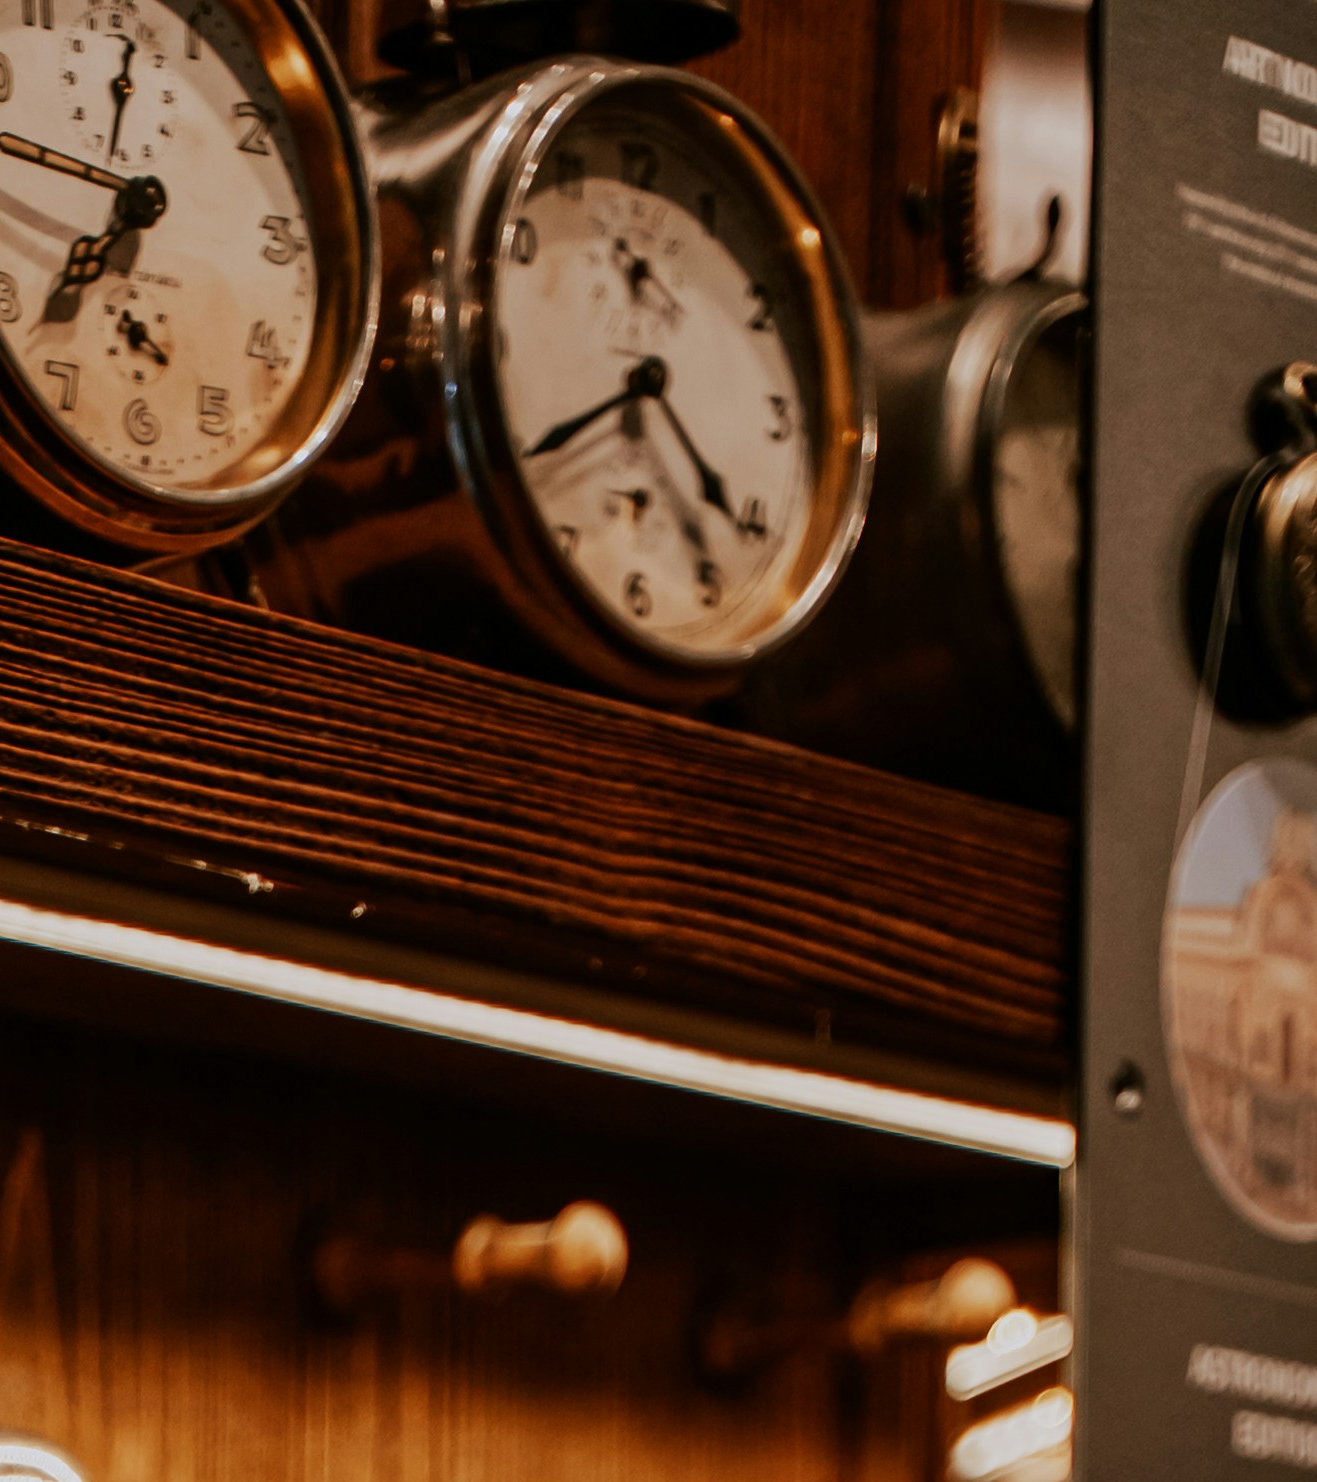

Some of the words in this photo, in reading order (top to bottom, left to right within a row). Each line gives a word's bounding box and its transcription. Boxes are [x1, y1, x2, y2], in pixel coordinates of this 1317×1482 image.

[232, 101, 275, 155] 2
[260, 214, 295, 266] 3
[247, 320, 289, 369] 4
[44, 359, 80, 411] 7
[197, 384, 235, 437] 5
[123, 398, 162, 446] 6
